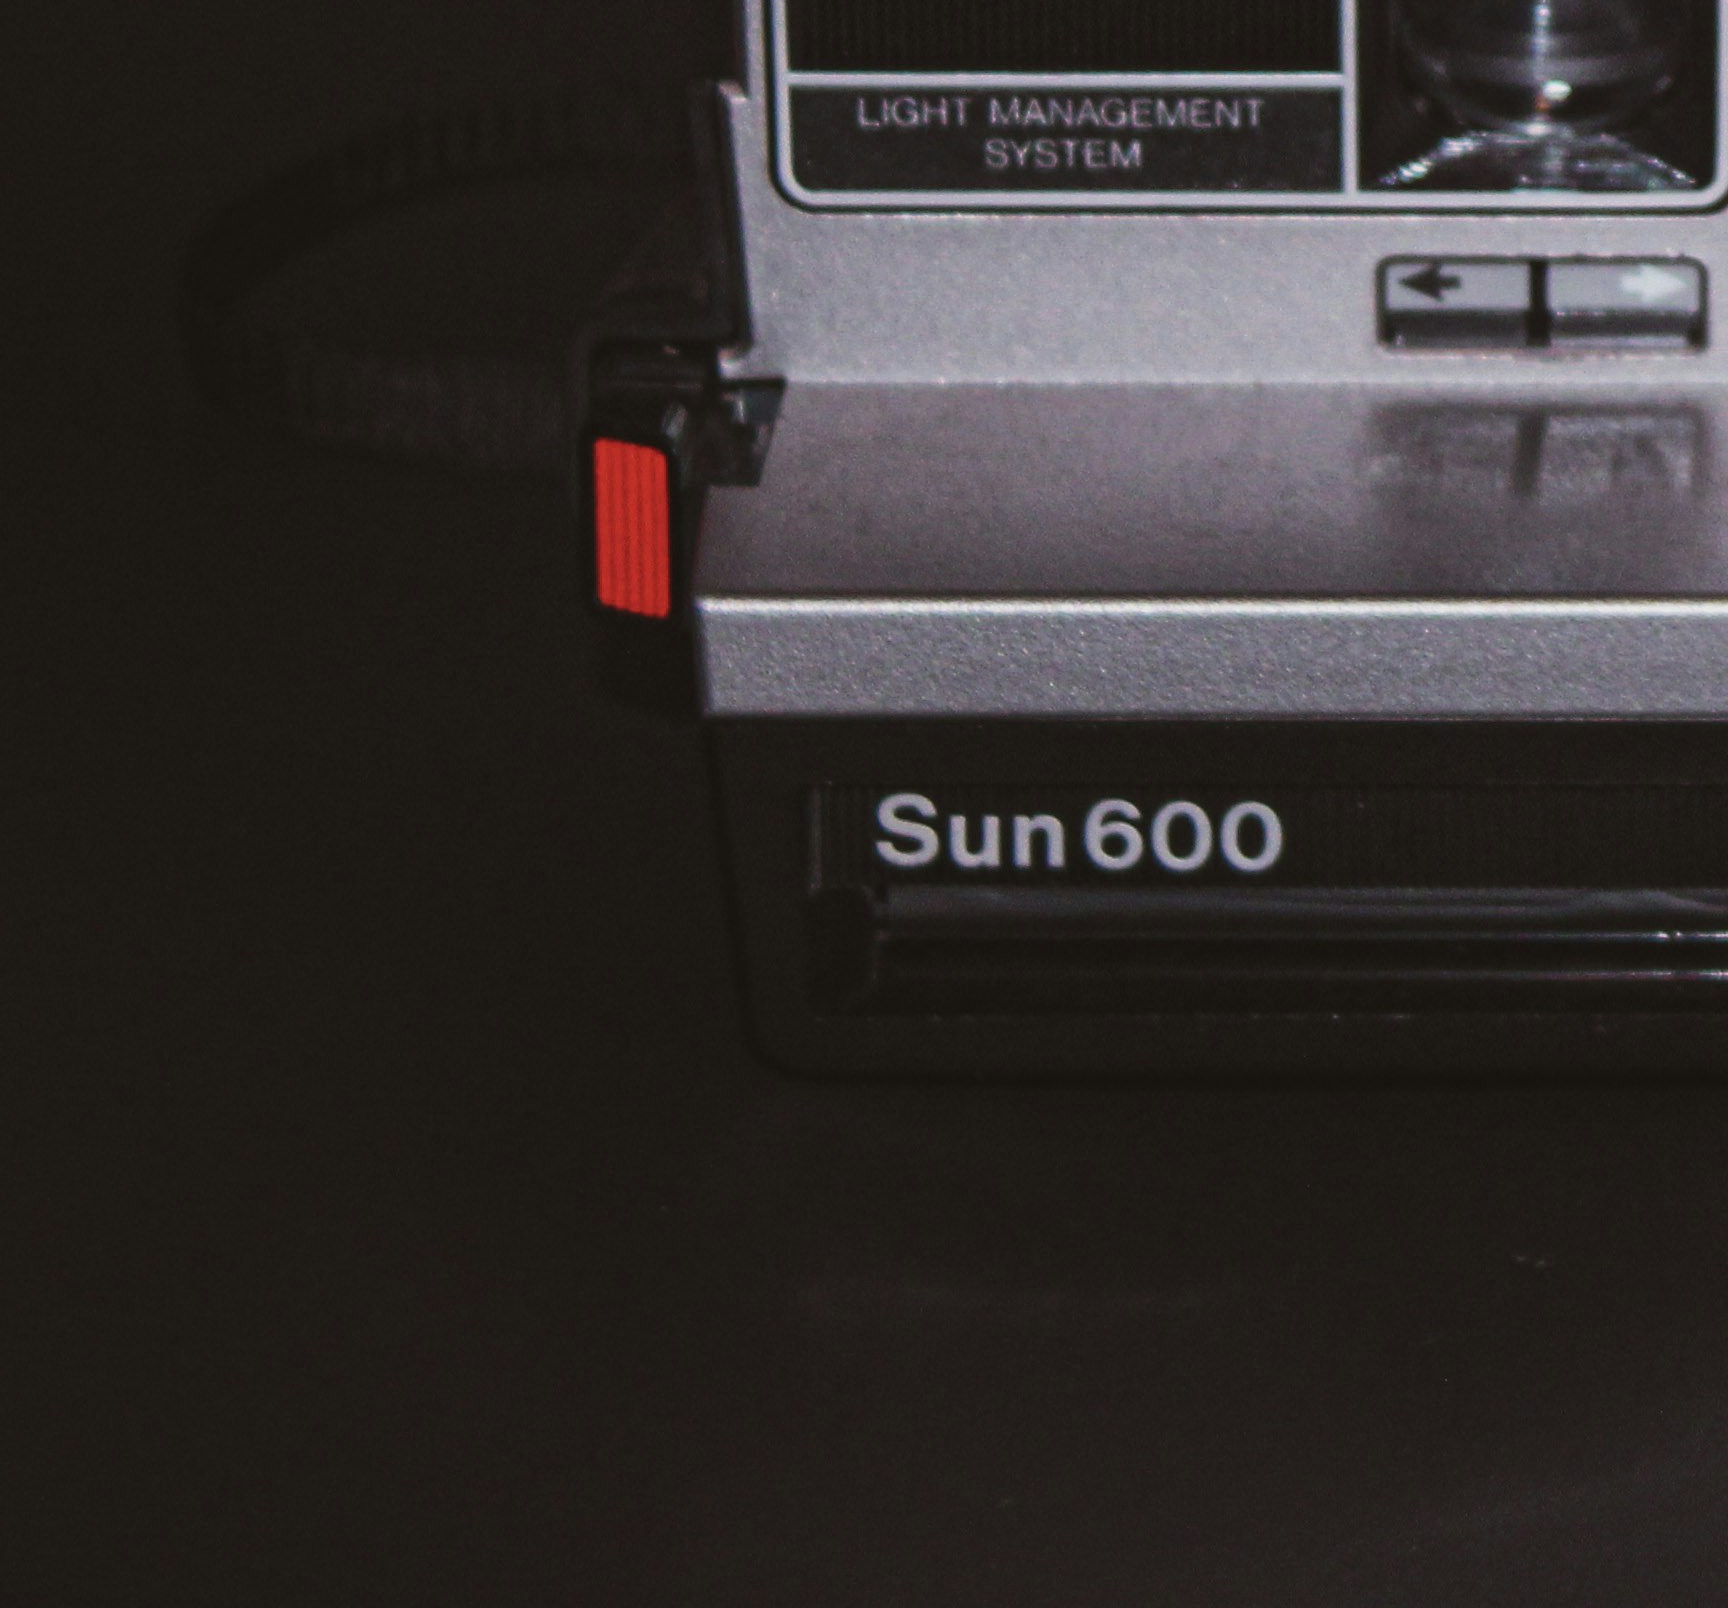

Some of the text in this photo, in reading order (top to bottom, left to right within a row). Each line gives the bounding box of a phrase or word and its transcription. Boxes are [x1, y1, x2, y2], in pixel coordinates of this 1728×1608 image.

[859, 98, 1263, 127] LIGHT MANAGEMENT
[984, 138, 1143, 170] SYSTEM
[876, 792, 1284, 873] Sun 600
